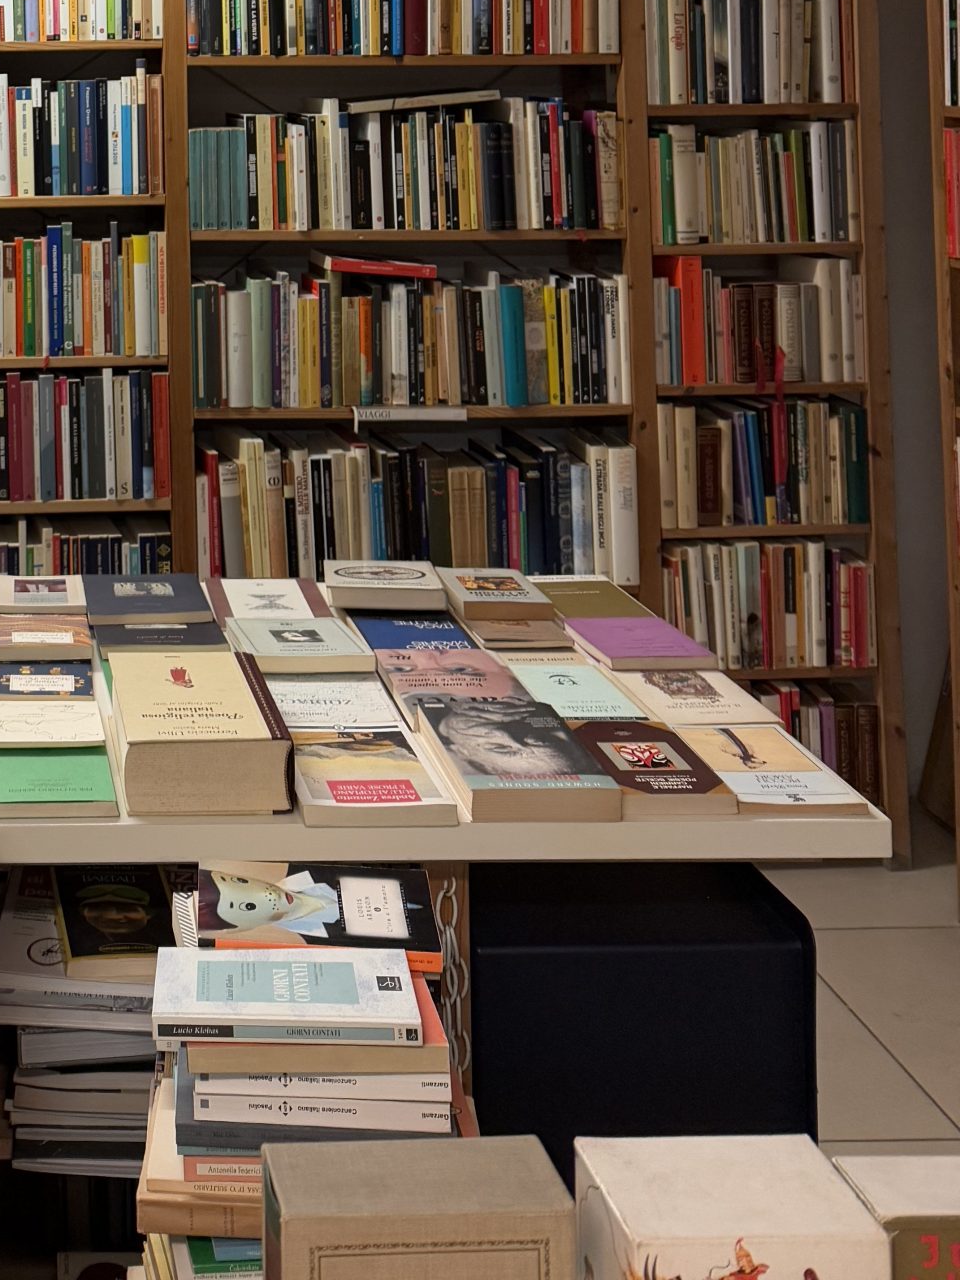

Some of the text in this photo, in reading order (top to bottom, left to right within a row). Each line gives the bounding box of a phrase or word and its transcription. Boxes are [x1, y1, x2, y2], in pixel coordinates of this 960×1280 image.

[357, 408, 391, 420] VIAGGI
[166, 705, 214, 714] italiana
[140, 711, 244, 721] Poesia religiosa
[544, 781, 600, 789] HOWARD
[336, 794, 417, 803] Andrea Zanzotto
[271, 968, 290, 1002] GIORNI
[291, 962, 311, 1003] CONTATI
[172, 1025, 219, 1035] Lucio Klobas
[286, 1028, 341, 1037] GIORNI CONTATI
[248, 1074, 450, 1090] Garzanti Canzoniere italiano Pasolini
[248, 1103, 450, 1121] Garzanti Canzoniere italiano Pasolini
[207, 1165, 261, 1176] Antonella Federici
